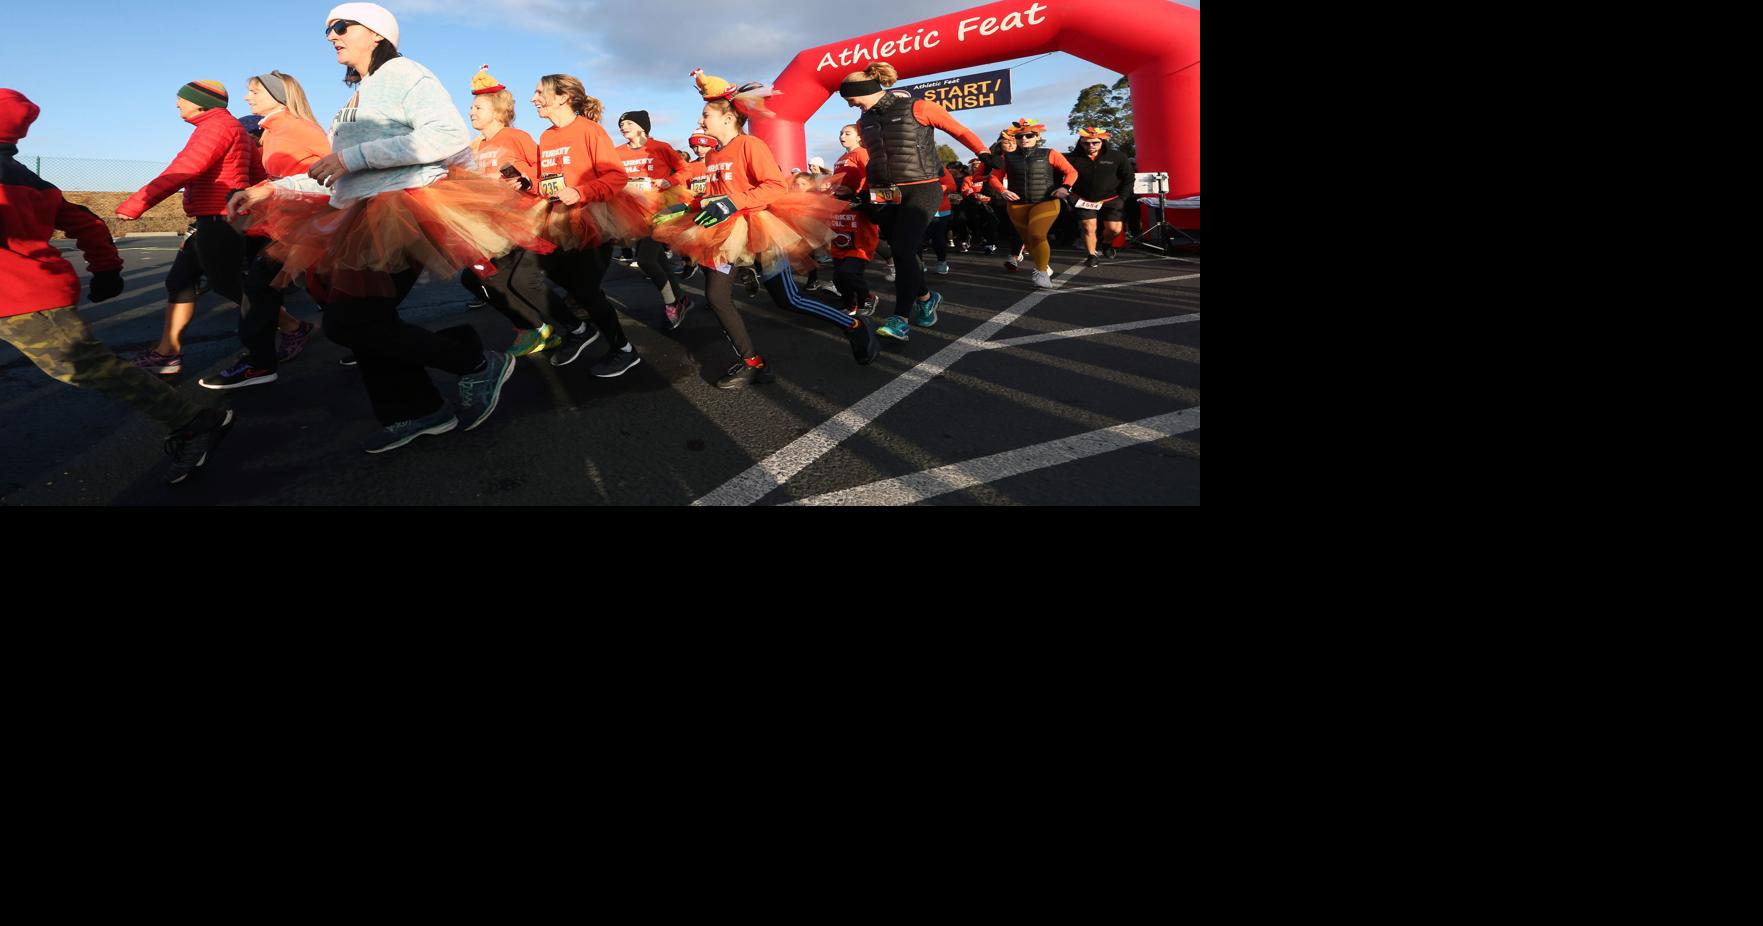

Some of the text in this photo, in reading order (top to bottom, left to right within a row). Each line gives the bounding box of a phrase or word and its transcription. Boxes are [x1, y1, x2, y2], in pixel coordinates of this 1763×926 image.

[816, 2, 1048, 72] Athletic Feat
[913, 78, 960, 90] Athletic Feat
[924, 80, 992, 101] START
[542, 181, 559, 196] 235
